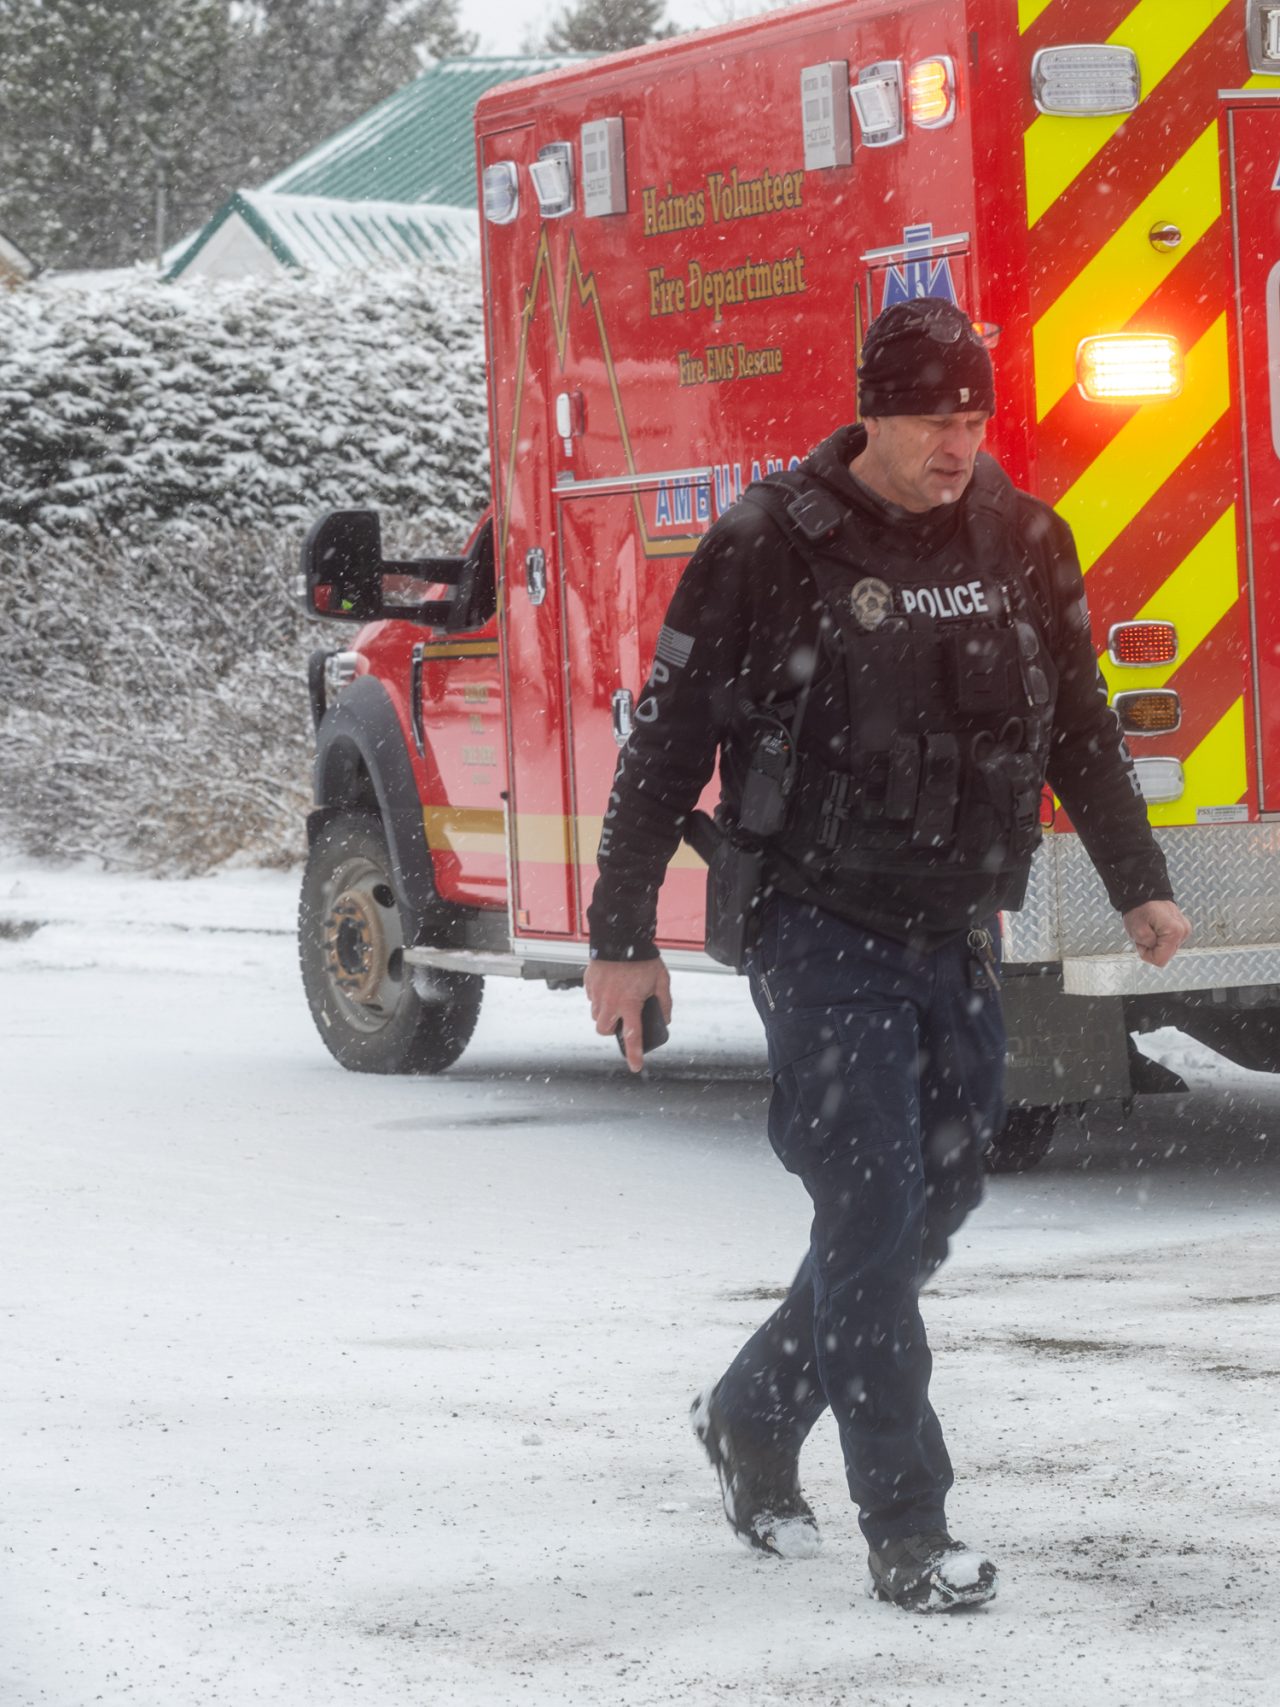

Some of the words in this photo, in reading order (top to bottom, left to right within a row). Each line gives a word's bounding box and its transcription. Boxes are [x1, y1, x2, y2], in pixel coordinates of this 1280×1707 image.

[642, 182, 706, 237] Haines
[708, 167, 804, 224] Volunteer
[648, 266, 685, 317] Fire
[688, 247, 806, 322] Department
[678, 350, 704, 387] Fire
[705, 344, 735, 383] EMS
[737, 342, 783, 379] Rescue
[901, 580, 989, 618] POLICE
